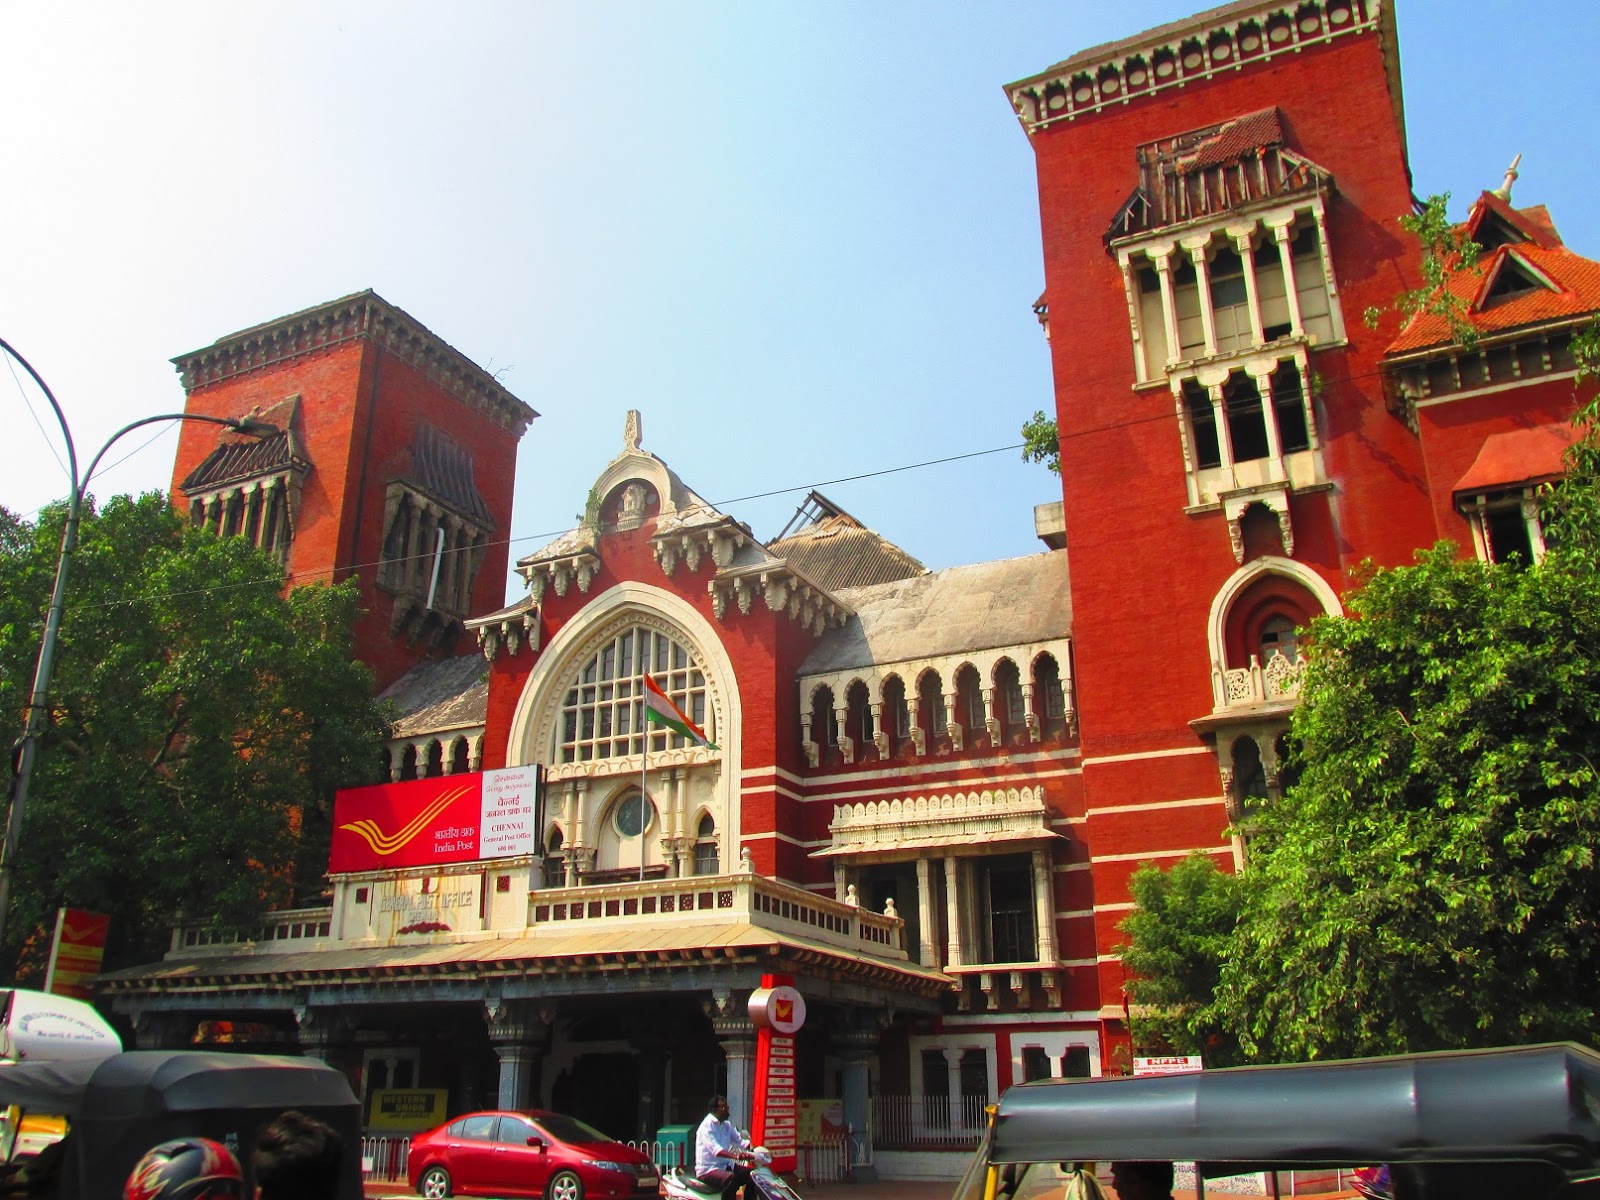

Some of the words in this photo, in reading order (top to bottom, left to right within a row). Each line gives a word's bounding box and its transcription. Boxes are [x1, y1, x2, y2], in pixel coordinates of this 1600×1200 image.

[497, 794, 520, 806] चेन्नई
[507, 807, 521, 816] डाक
[434, 827, 460, 839] भारतीय
[460, 826, 475, 838] डाक
[491, 822, 524, 832] CHENNAI
[483, 834, 504, 843] General
[504, 833, 515, 841] Post
[516, 832, 532, 840] Office
[434, 842, 455, 853] India
[456, 840, 474, 851] Post
[380, 895, 416, 912] GENERAL
[417, 893, 440, 910] POST
[441, 889, 473, 908] OFFICE
[384, 1095, 426, 1103] WESTERN
[395, 1103, 425, 1111] UNION
